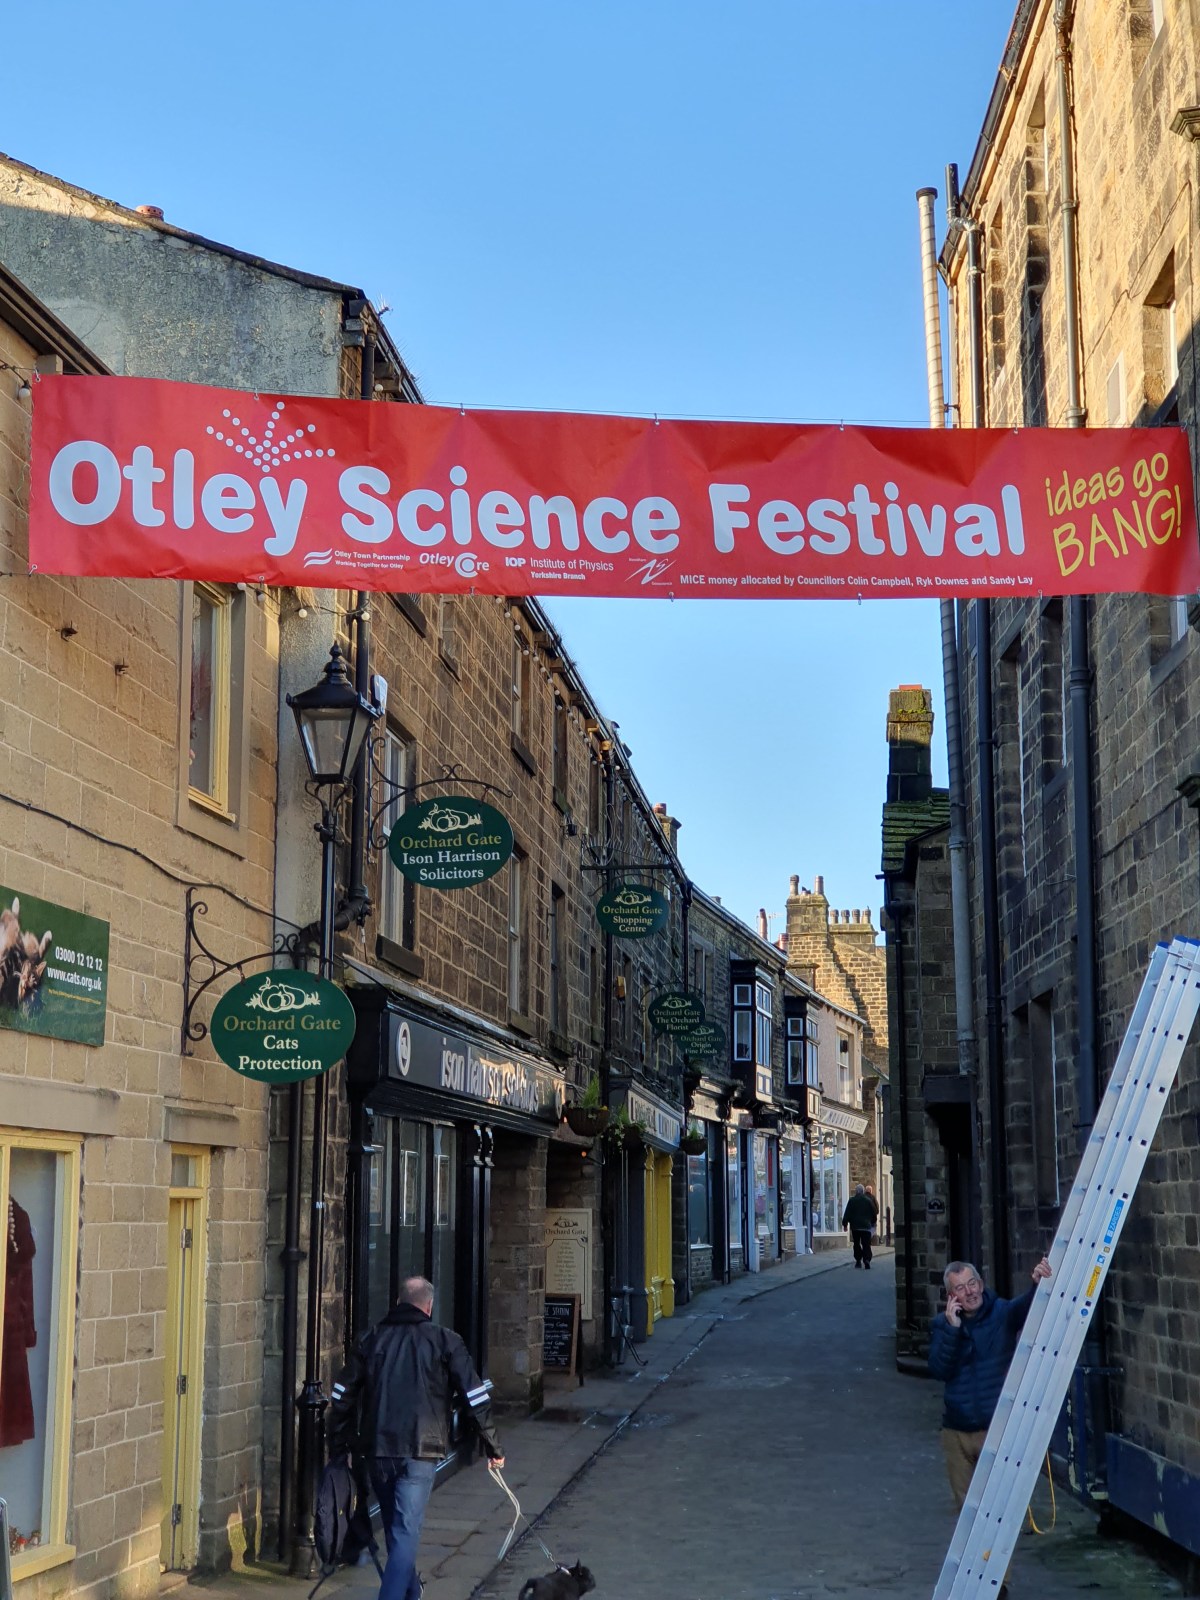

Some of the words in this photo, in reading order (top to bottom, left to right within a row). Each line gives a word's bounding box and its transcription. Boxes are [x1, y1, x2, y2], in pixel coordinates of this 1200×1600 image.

[1045, 466, 1125, 517] ideas
[1133, 452, 1169, 498] go
[49, 440, 308, 556] Otley
[338, 465, 681, 554] Science
[708, 481, 1025, 557] Festival
[1053, 485, 1181, 577] BANG!
[334, 550, 352, 560] Otley
[353, 551, 371, 559] Town
[372, 553, 411, 562] Partnership
[335, 560, 356, 568] Working
[505, 557, 526, 568] IOP
[530, 557, 566, 569] Institute
[568, 559, 577, 569] of
[579, 560, 614, 573] Physics
[531, 571, 562, 579] Yorkshire
[563, 572, 586, 580] Branch
[680, 575, 705, 584] MICE
[708, 577, 738, 587] money
[741, 575, 781, 585] allocated
[784, 575, 794, 587] by
[797, 575, 845, 585] Councillors
[848, 576, 868, 586] Colin
[871, 576, 914, 587] Campbell,
[916, 577, 933, 588] Ryk
[935, 576, 969, 586] Downes
[971, 576, 988, 585] and
[989, 576, 1016, 587] Sandy
[1018, 576, 1033, 586] Lay
[400, 834, 462, 850] Orchard
[466, 833, 502, 846] Gate
[402, 852, 434, 865] Ison
[438, 850, 501, 863] Harrison
[420, 867, 484, 881] Solicitors
[602, 905, 640, 914] Orchard
[642, 906, 663, 914] Gate
[612, 916, 653, 926] Shopping
[618, 924, 647, 932] Centre
[55, 946, 76, 964] 03000
[77, 952, 84, 967] 12
[86, 955, 94, 969] 12
[95, 958, 103, 972] 12
[47, 967, 102, 992] www.cats.org.uk
[223, 1015, 296, 1031] Orchard
[300, 1014, 342, 1030] Gate
[670, 1016, 700, 1024] Orchard
[263, 1035, 299, 1050] Cats
[238, 1055, 322, 1070] Protection
